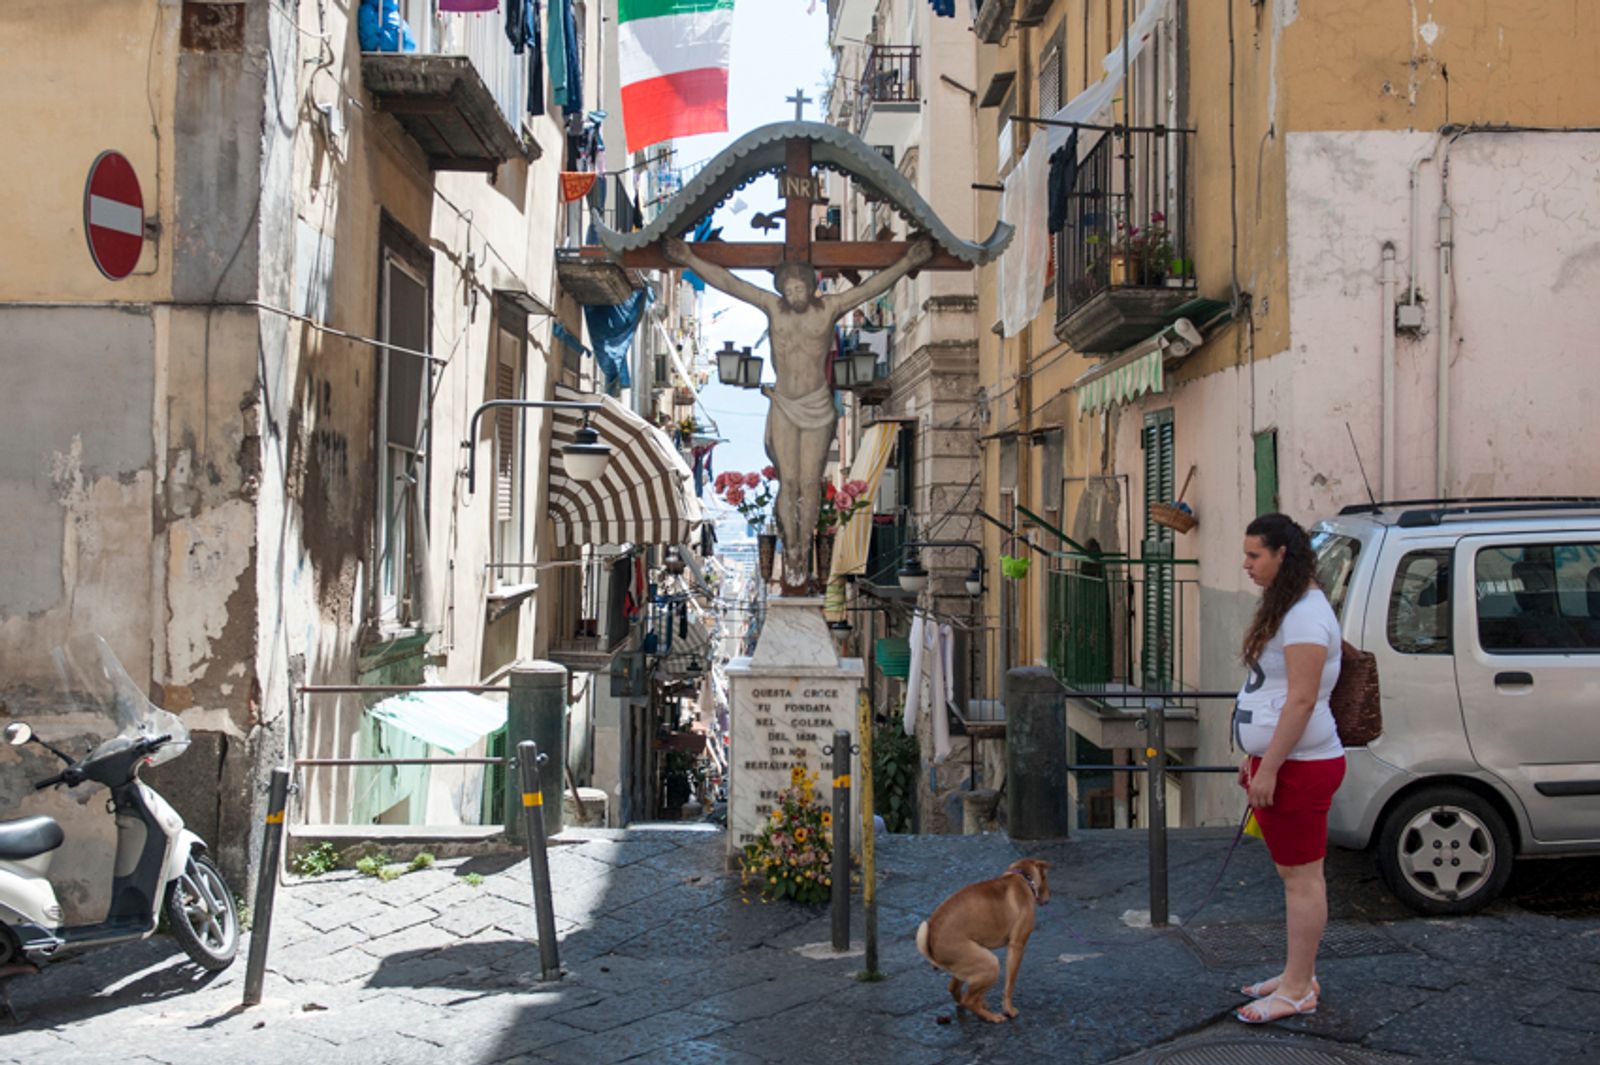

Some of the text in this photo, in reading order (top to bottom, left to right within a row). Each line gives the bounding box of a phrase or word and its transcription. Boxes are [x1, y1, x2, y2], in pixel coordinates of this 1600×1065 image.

[752, 688, 792, 698] QUESTA
[758, 703, 832, 712] FU FONDATA
[755, 718, 834, 728] NEL COLERA
[768, 732, 788, 741] DEL
[771, 747, 785, 756] DA
[745, 761, 808, 771] RESTAURATA
